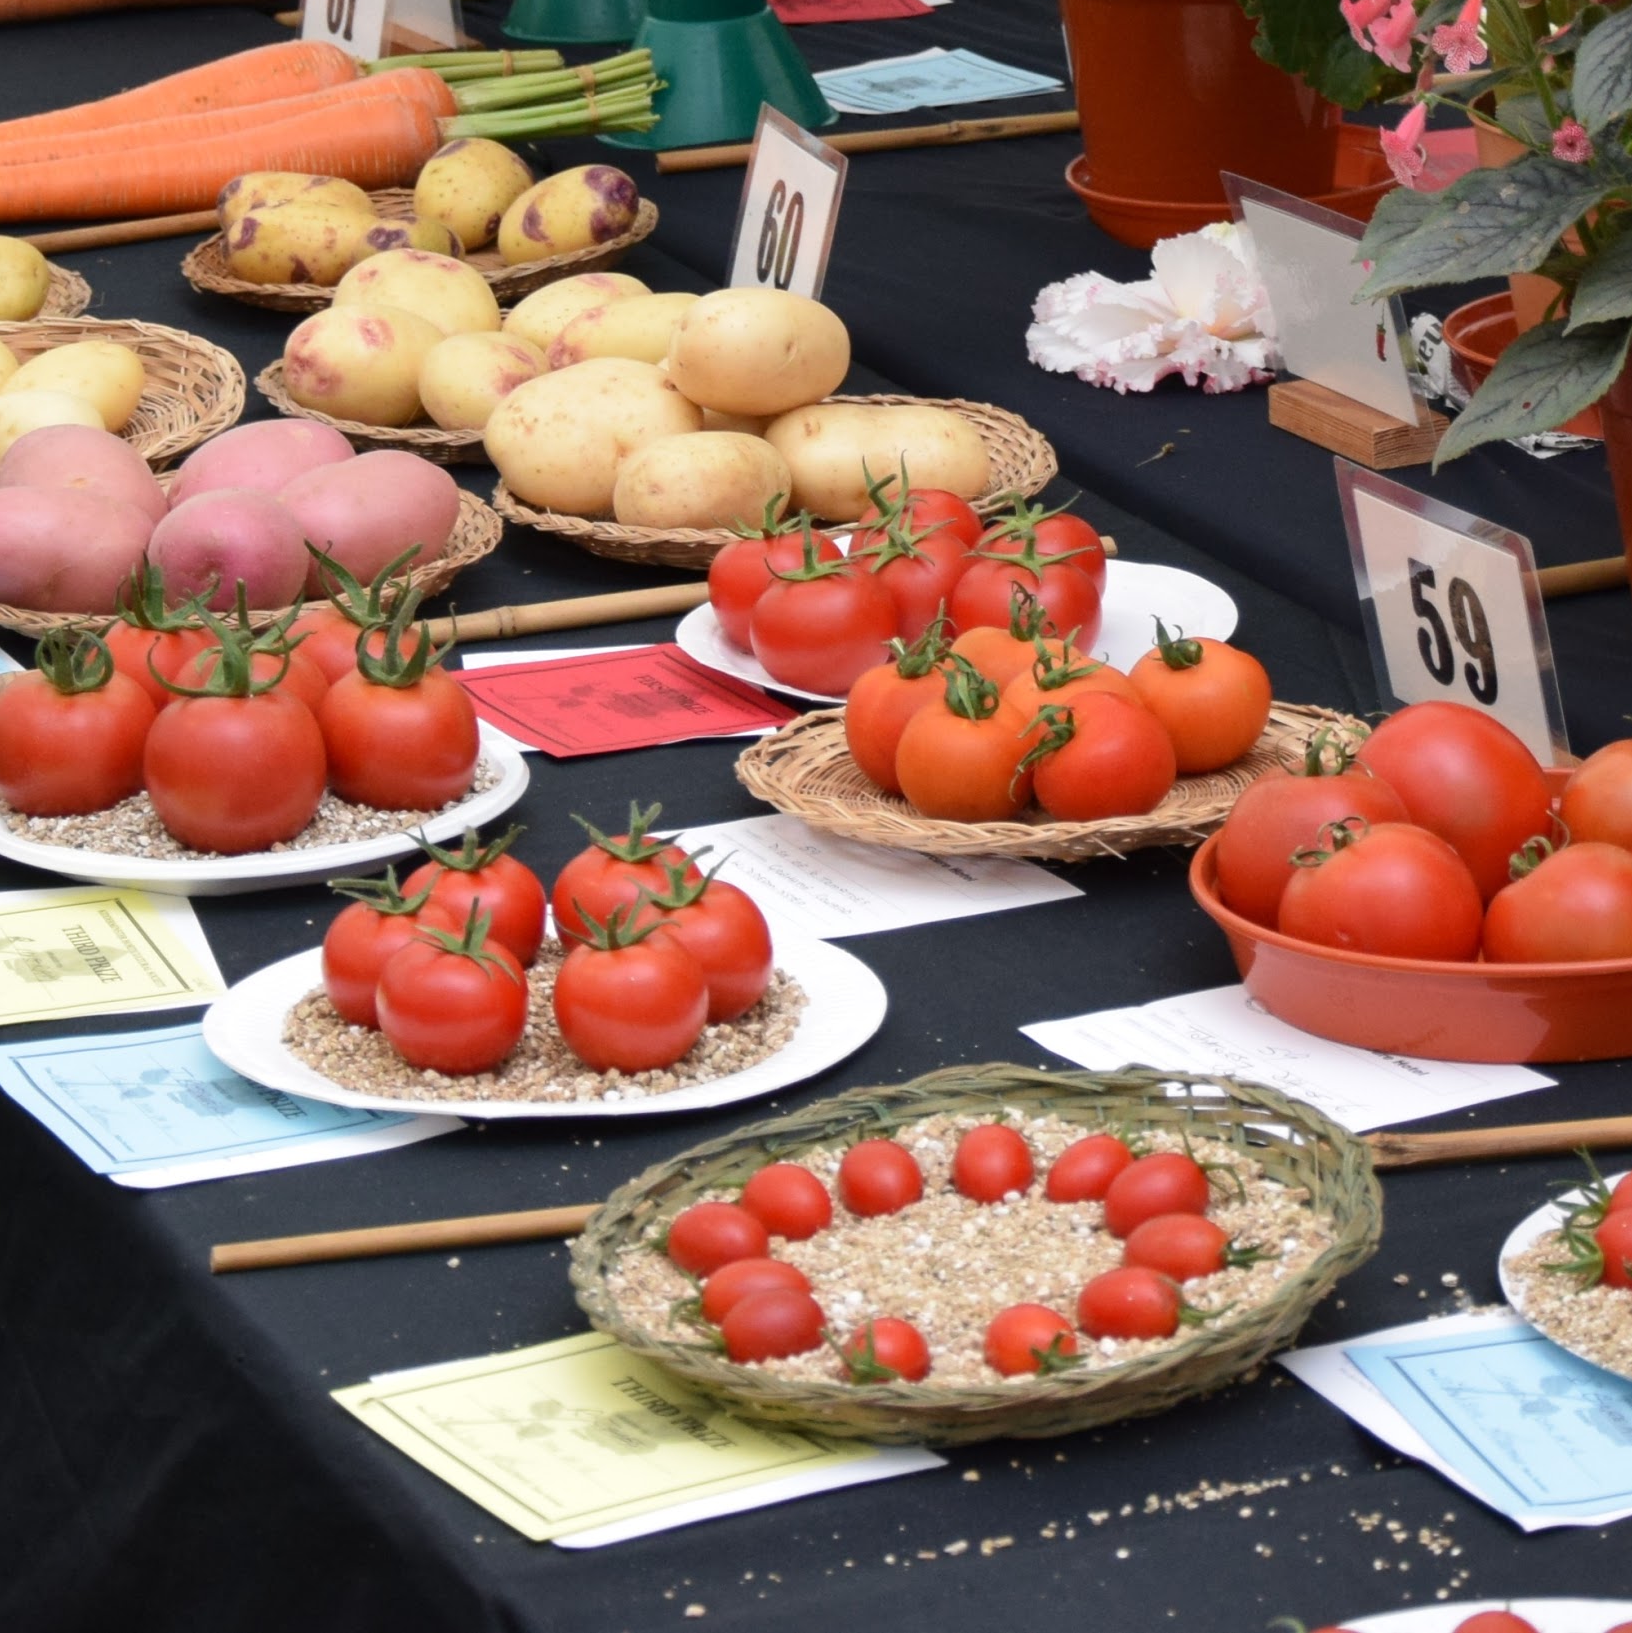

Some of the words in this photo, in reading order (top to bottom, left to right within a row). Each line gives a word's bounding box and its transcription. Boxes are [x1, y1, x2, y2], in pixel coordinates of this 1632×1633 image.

[757, 179, 804, 289] 60
[1408, 557, 1498, 705] 59
[61, 925, 102, 956] THIRD
[84, 955, 124, 983] PRIZE
[260, 1090, 308, 1119] PRIZE
[610, 1378, 682, 1416] THIRD
[670, 1416, 738, 1451] PRIZE
